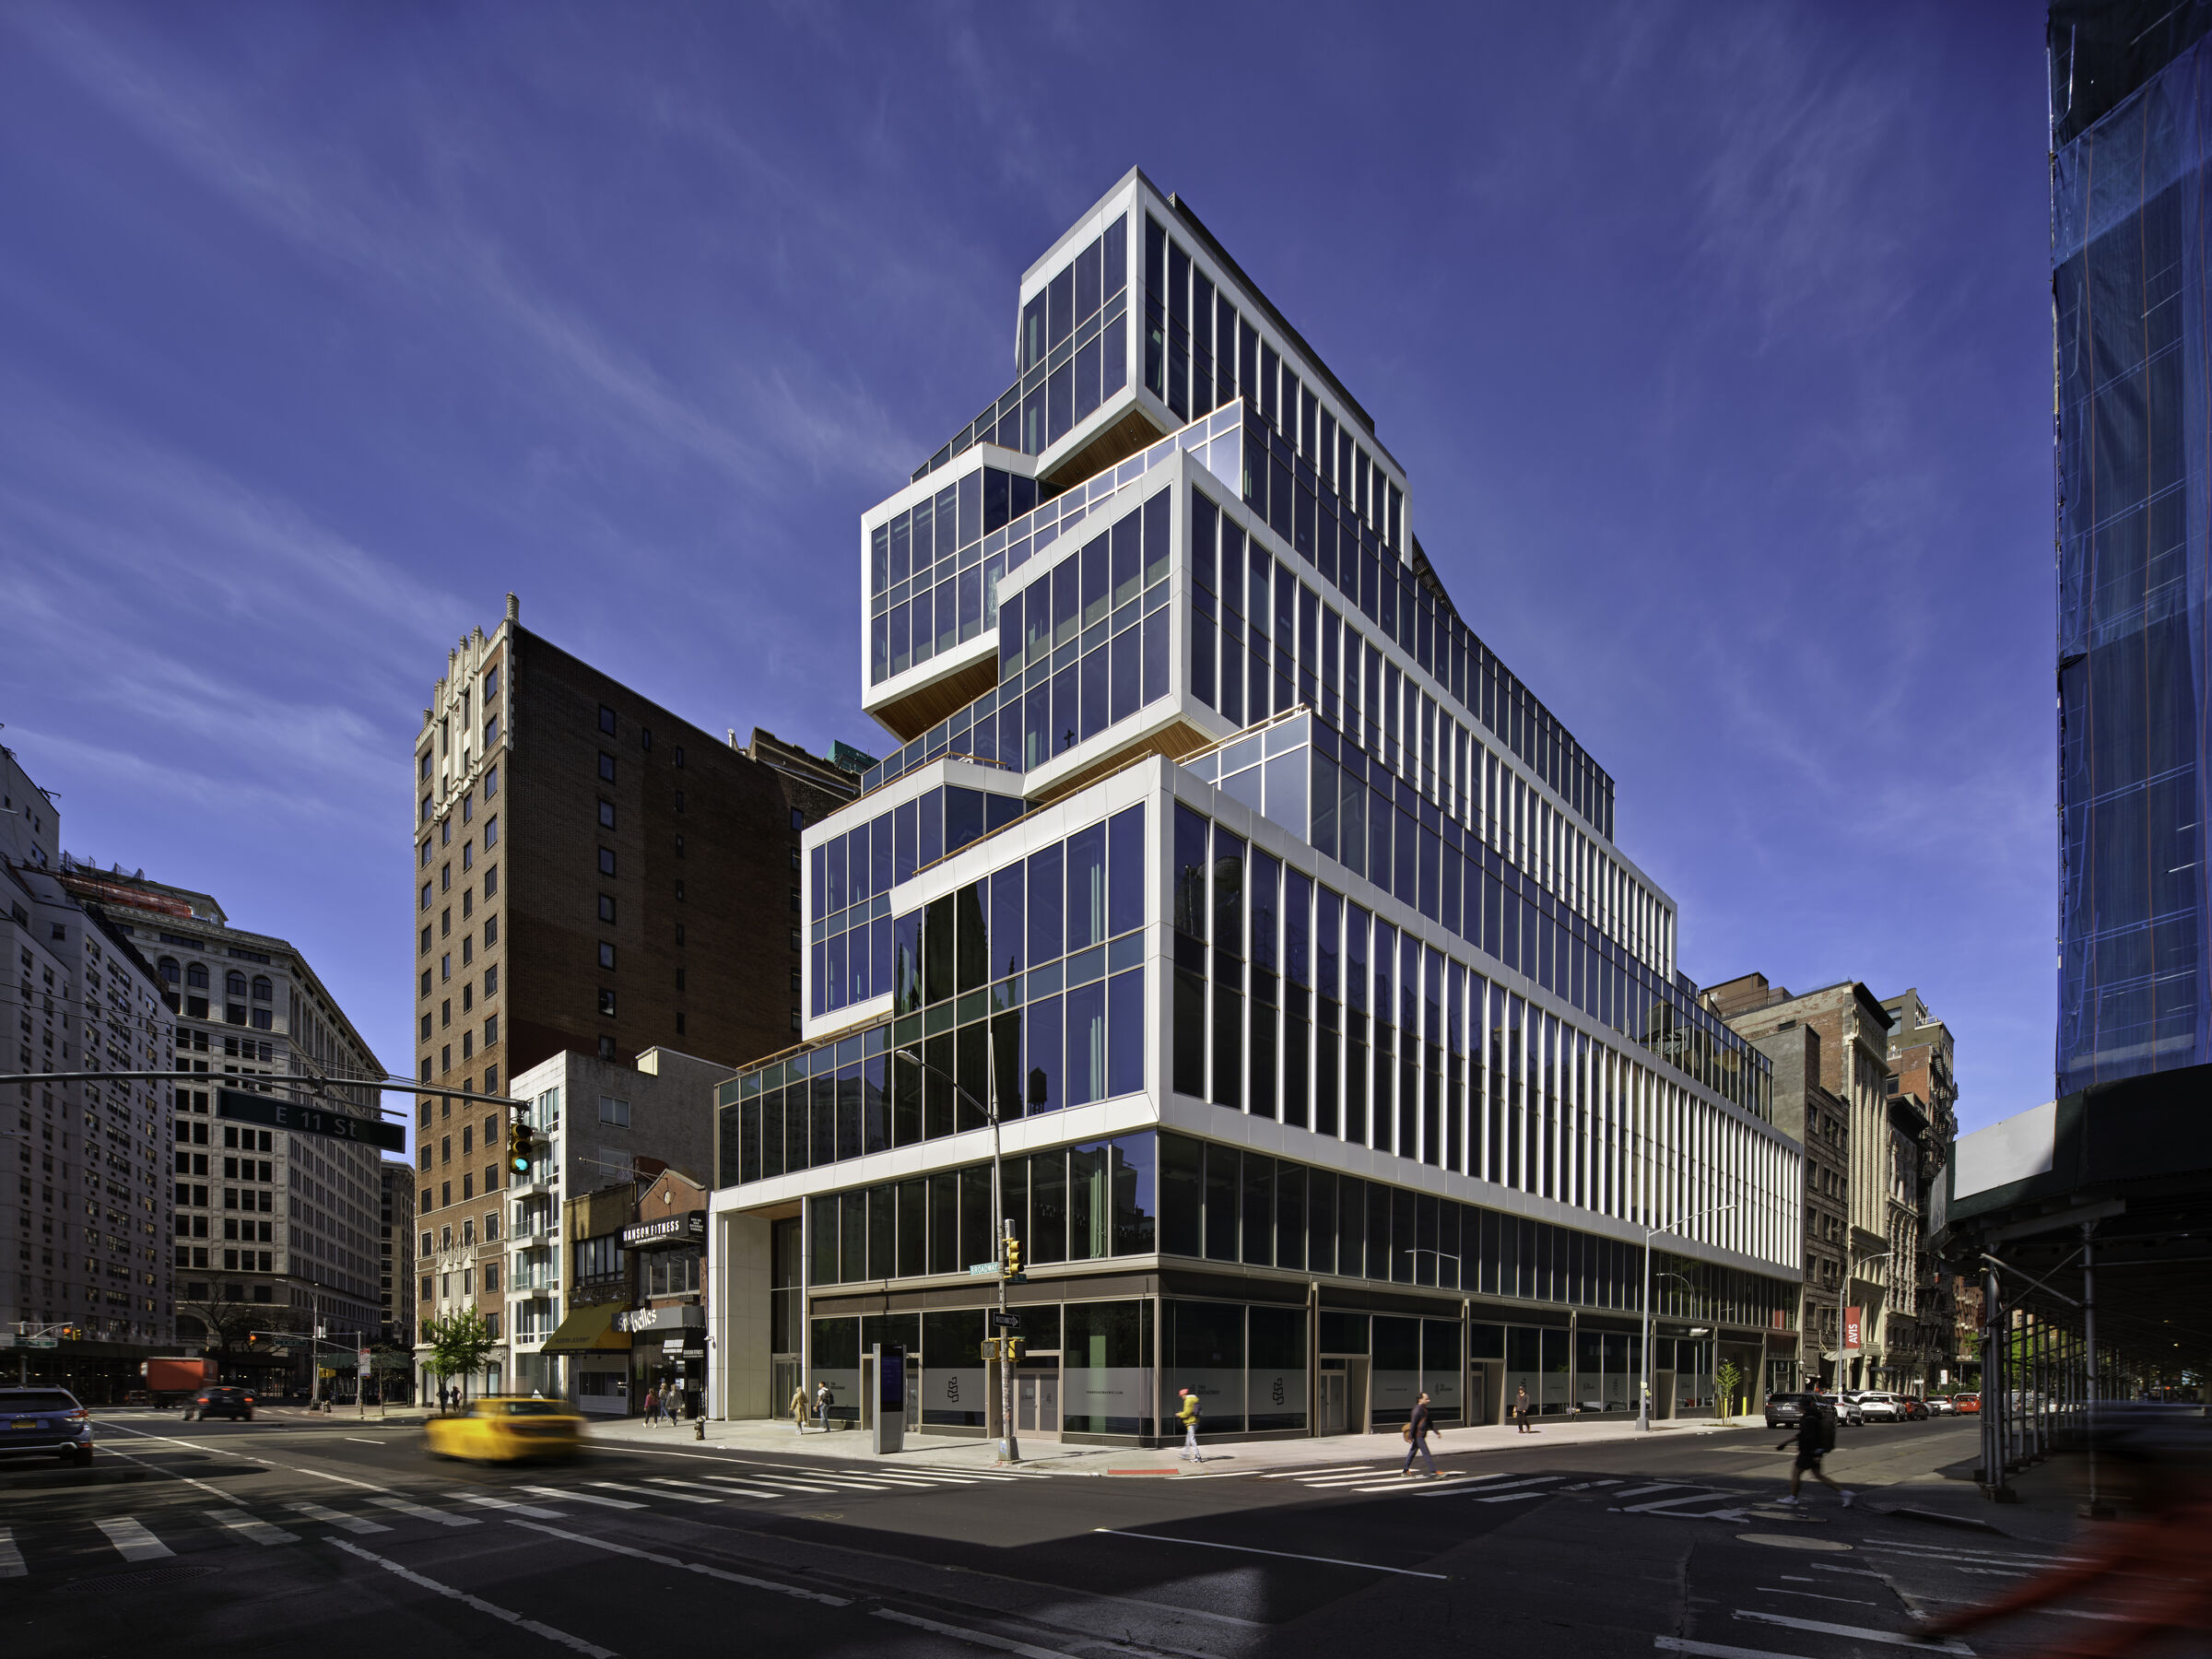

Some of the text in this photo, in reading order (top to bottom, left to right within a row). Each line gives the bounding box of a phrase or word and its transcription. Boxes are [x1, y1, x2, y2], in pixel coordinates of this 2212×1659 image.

[276, 1106, 357, 1137] E 11 St
[623, 1226, 650, 1241] HANSON
[651, 1220, 679, 1235] FITNESS
[971, 1264, 998, 1275] BROADWAY
[1848, 1324, 1858, 1344] AVIS
